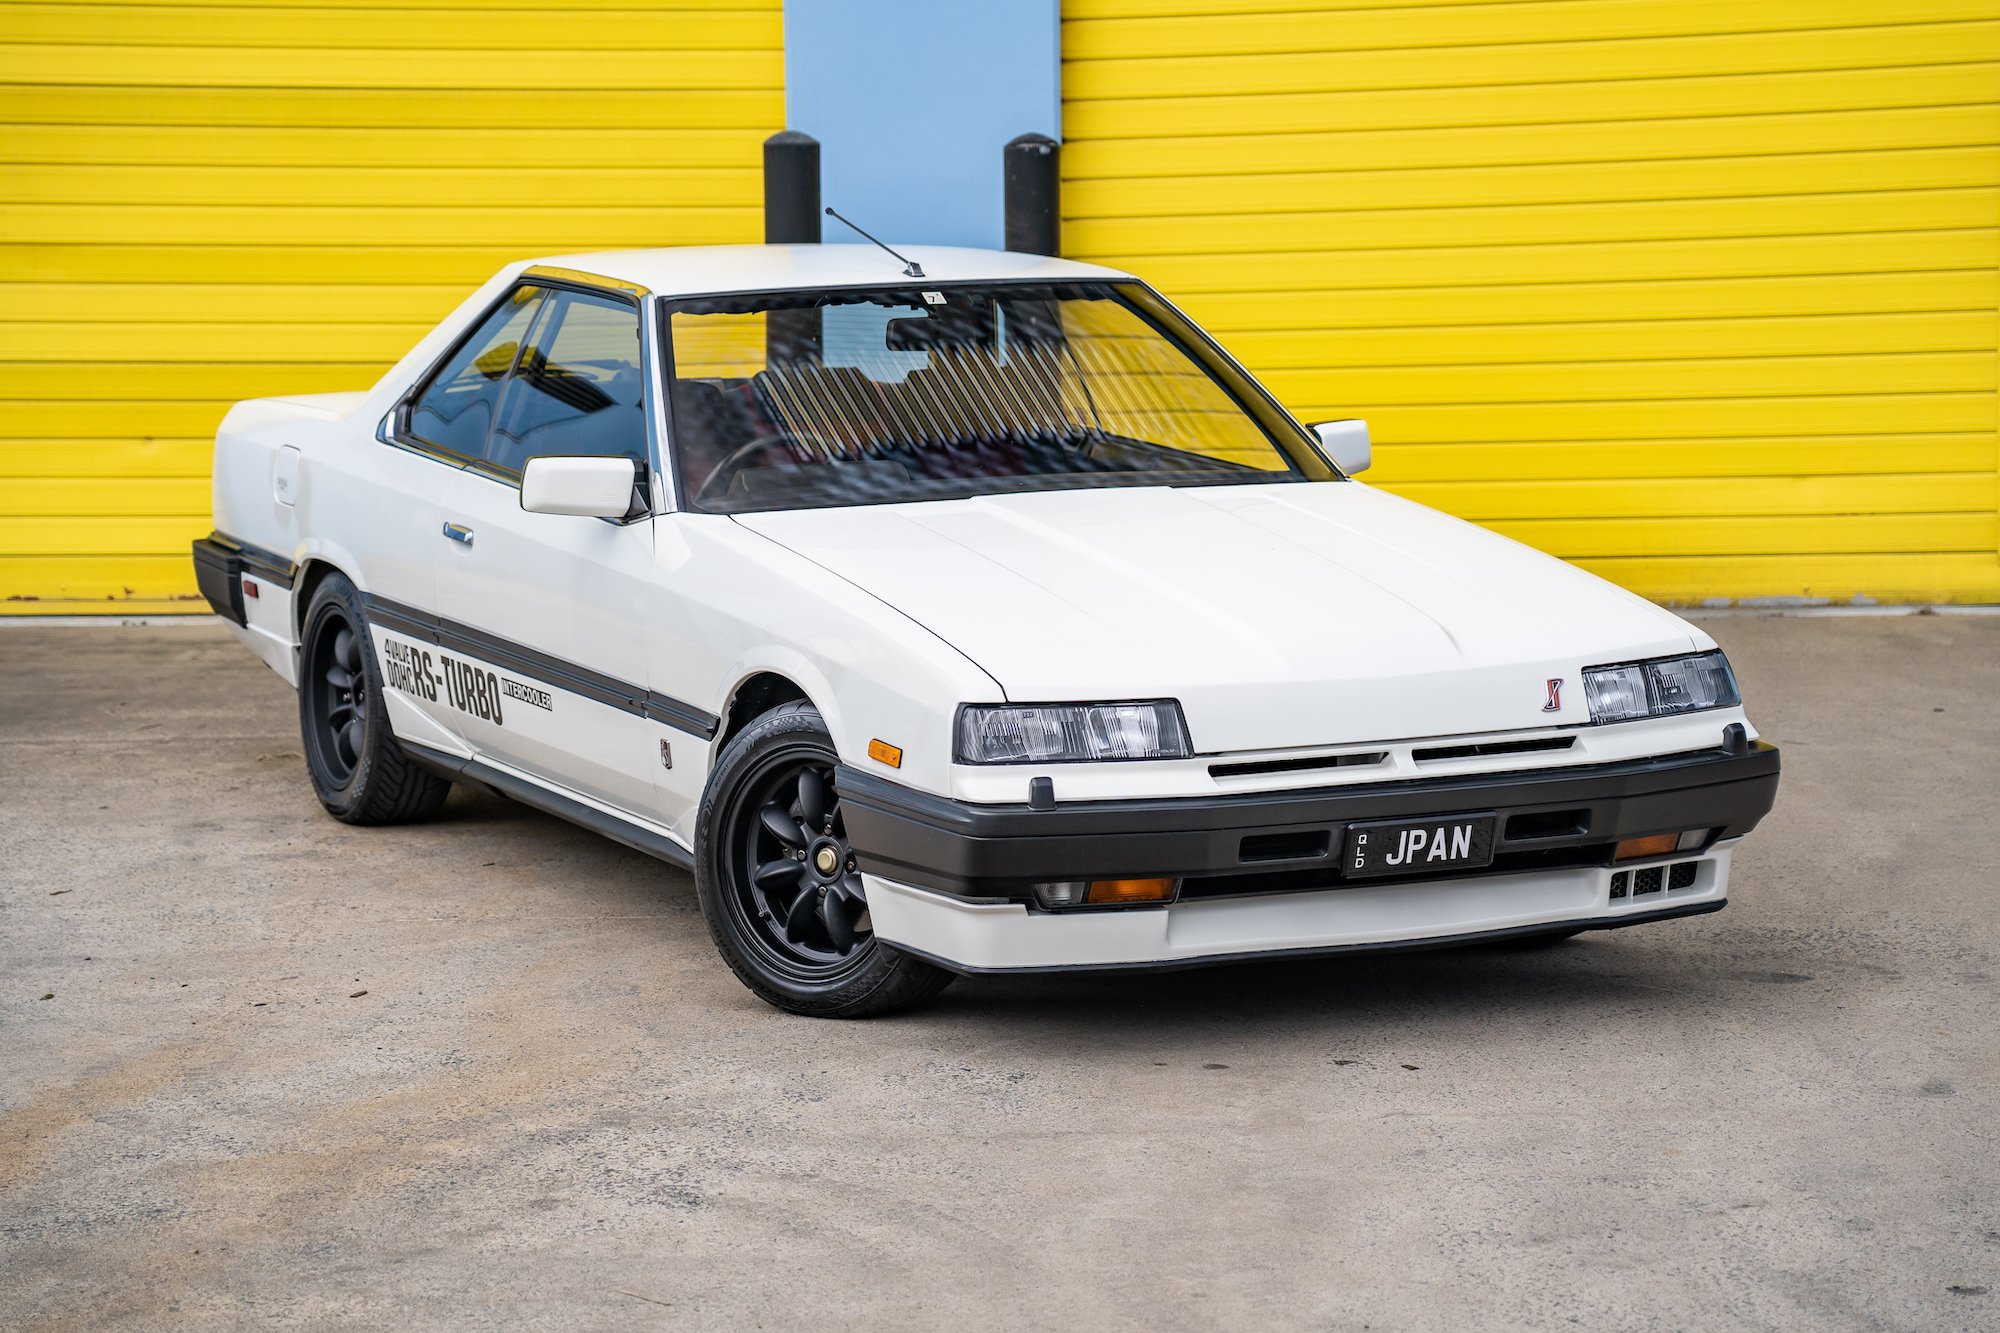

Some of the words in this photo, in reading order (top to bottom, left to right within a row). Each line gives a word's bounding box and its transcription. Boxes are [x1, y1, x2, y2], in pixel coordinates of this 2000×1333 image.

[386, 659, 415, 695] DOHC
[410, 646, 503, 726] RS-TURBO
[501, 677, 553, 712] INTERCOOLER
[1355, 834, 1368, 869] QLD
[1385, 824, 1473, 866] JPAN
